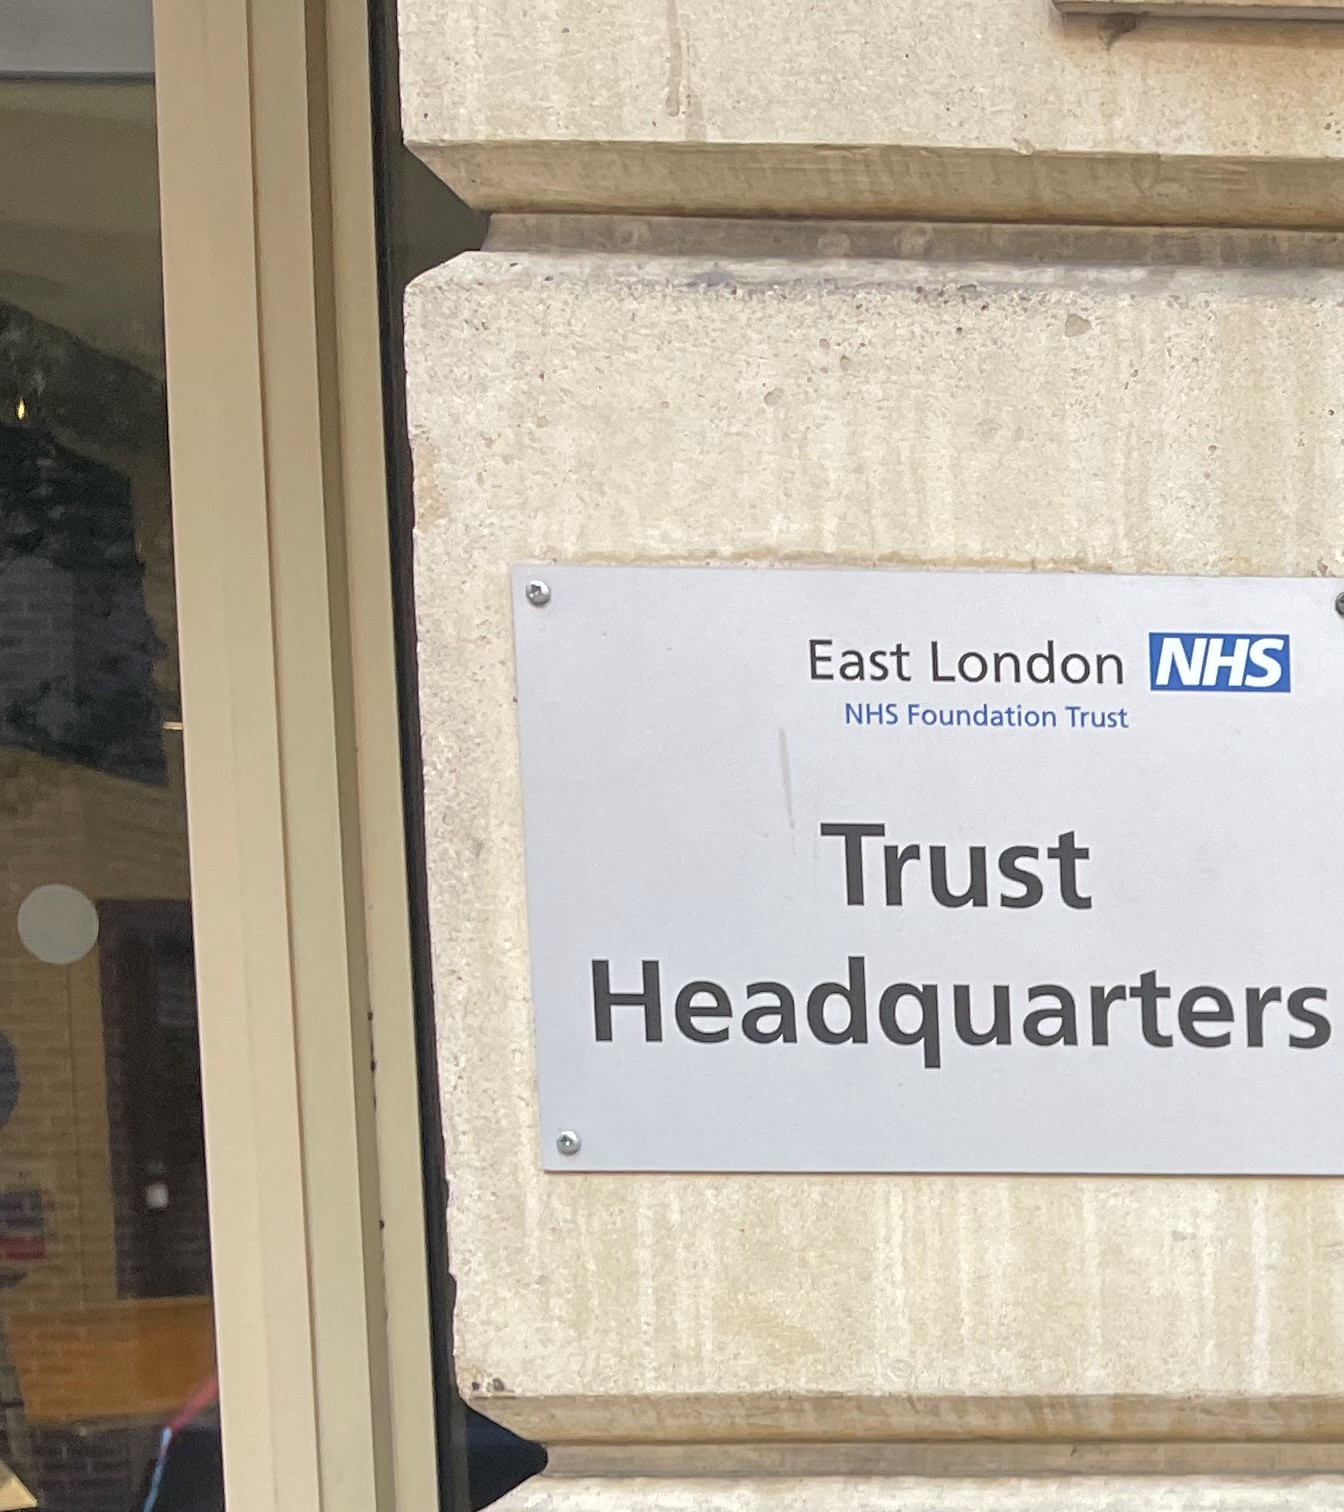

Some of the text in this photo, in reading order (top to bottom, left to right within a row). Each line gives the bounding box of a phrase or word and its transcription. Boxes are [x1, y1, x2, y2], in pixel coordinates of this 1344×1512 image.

[808, 636, 1285, 688] East London NHS
[845, 703, 1129, 728] NHS Foundation Trust
[820, 822, 1093, 910] Trust
[591, 955, 1333, 1070] Headquarters
